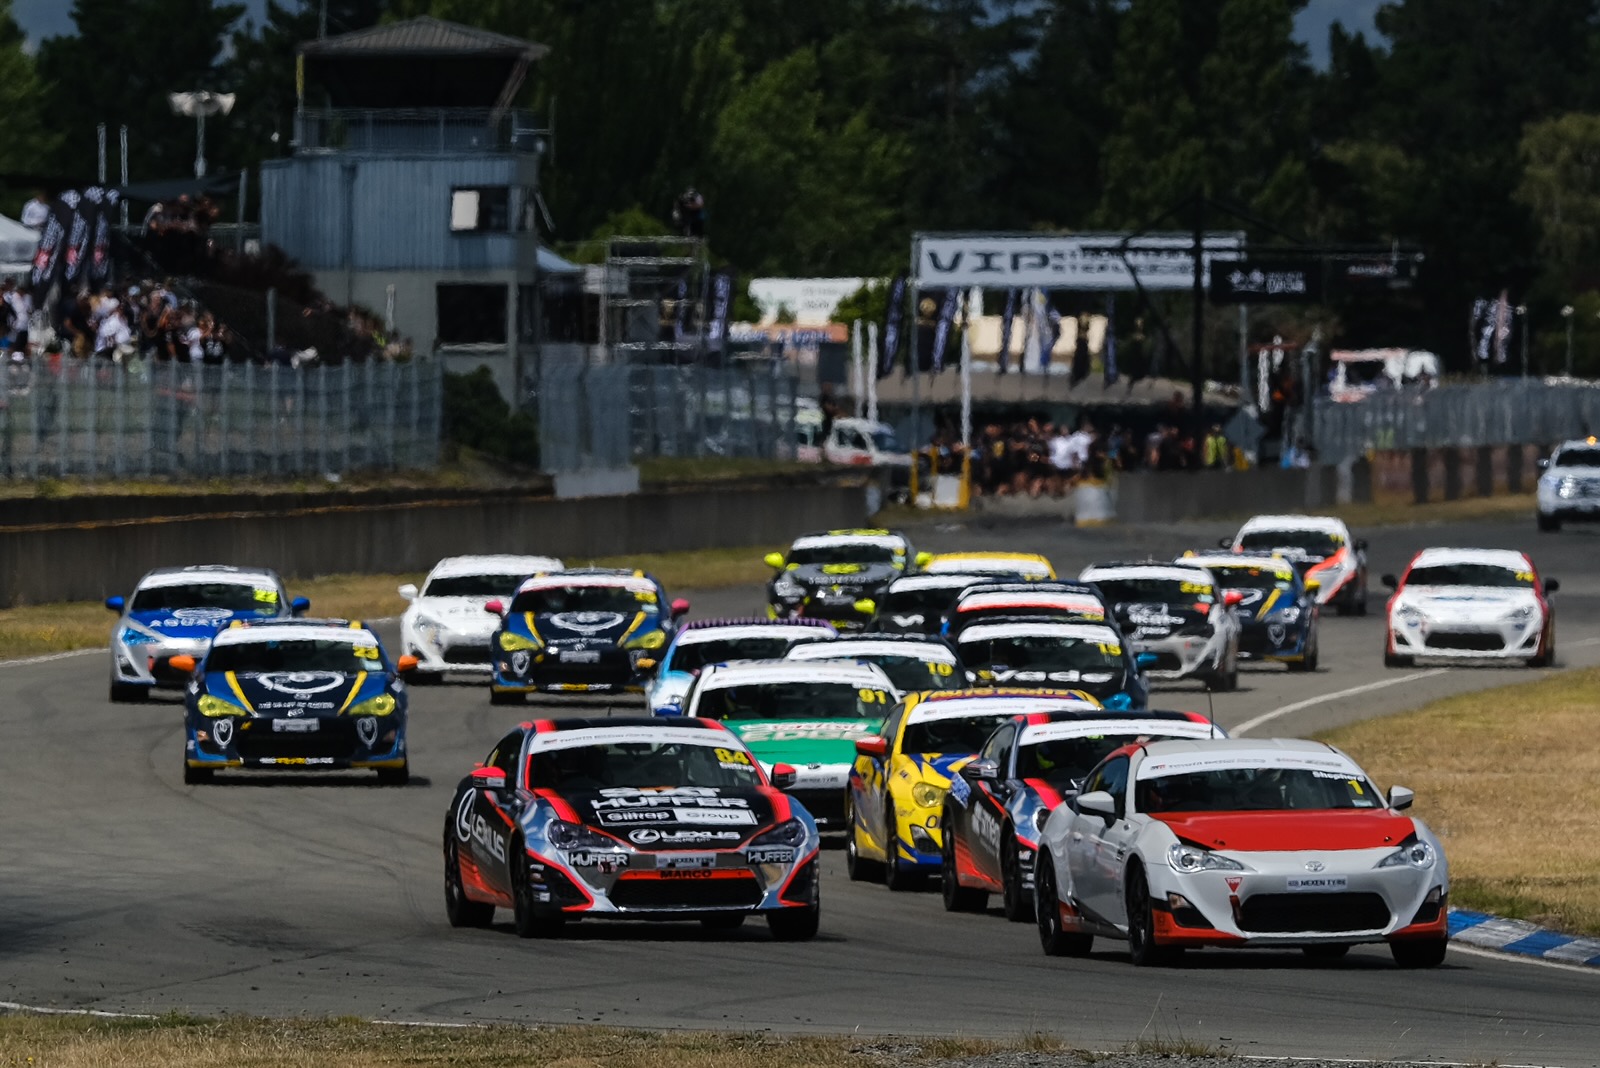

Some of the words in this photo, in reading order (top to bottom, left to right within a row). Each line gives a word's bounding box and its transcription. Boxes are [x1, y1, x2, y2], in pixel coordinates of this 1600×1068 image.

[928, 251, 1050, 272] VIP
[928, 662, 953, 677] 10
[714, 748, 750, 765] 84
[1312, 770, 1365, 782] Shepherd
[1348, 780, 1364, 795] 1
[591, 796, 749, 809] HUFFER
[607, 812, 670, 821] Giltrap
[686, 812, 740, 820] Group
[471, 813, 505, 864] LEXUS
[661, 830, 741, 840] LEXUS
[570, 853, 628, 866] HUFFER
[748, 851, 793, 863] HUFFER
[660, 870, 712, 879] MARCO
